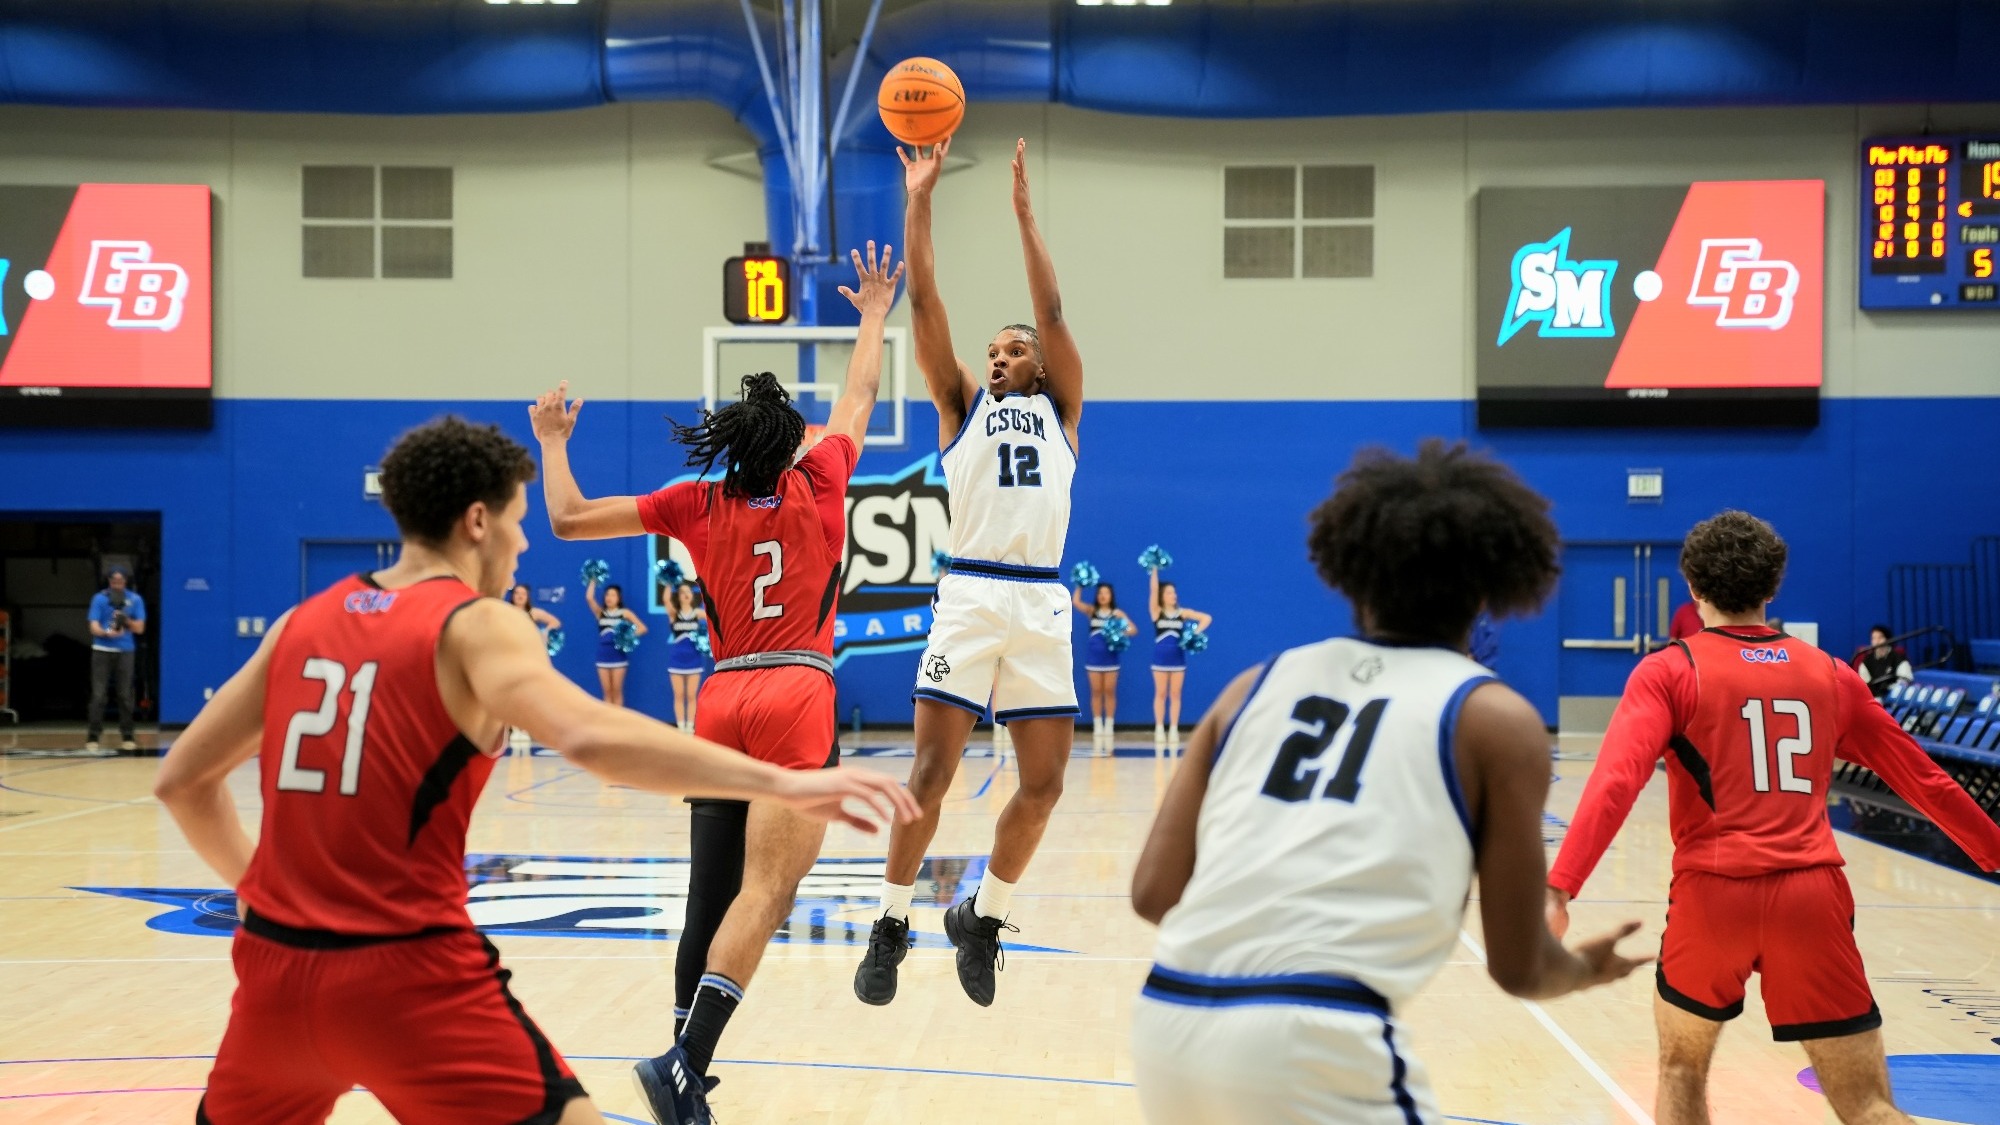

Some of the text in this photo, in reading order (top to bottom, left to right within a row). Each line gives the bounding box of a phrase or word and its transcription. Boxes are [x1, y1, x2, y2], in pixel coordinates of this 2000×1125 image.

[1967, 141, 2000, 158] Hom
[78, 239, 188, 331] EB
[747, 278, 783, 320] 10
[1510, 244, 1609, 333] SM
[1686, 238, 1799, 331] EB
[1974, 249, 1993, 278] 5
[986, 408, 1047, 442] CSUSM
[997, 443, 1042, 487] 12
[752, 540, 783, 622] 2
[1740, 648, 1790, 663] CCAA
[277, 656, 379, 796] 21
[1260, 694, 1391, 804] 21
[1740, 697, 1813, 795] 12
